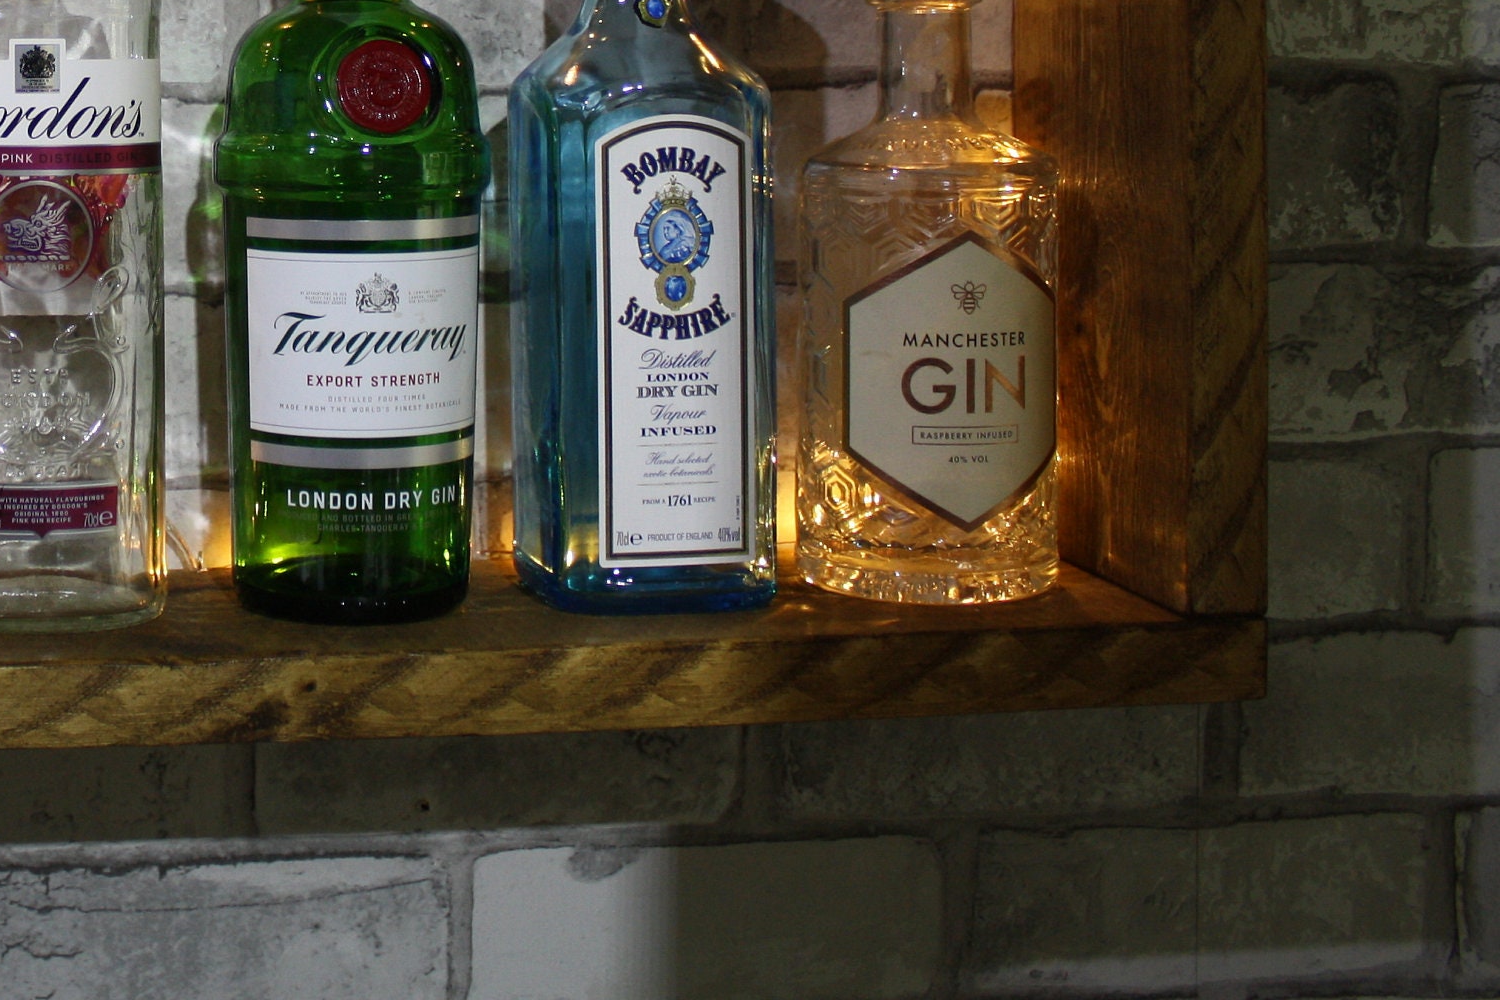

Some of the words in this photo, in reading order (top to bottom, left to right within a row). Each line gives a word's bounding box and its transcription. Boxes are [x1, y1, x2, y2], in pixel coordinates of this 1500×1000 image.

[1, 152, 33, 164] PINK
[39, 152, 112, 164] DISTILLED
[620, 146, 726, 194] BOMBAY
[617, 293, 731, 340] SAPPHIRE
[272, 311, 468, 367] Tanqueray
[902, 331, 1026, 348] MANCHESTER
[638, 348, 717, 370] Distilled
[306, 374, 363, 388] EXPORT
[370, 371, 441, 388] STRENGTH
[647, 371, 710, 383] LONDON
[636, 385, 678, 398] DRY
[681, 383, 719, 397] GIN
[901, 355, 1026, 415] GIN
[328, 395, 373, 403] DISTILLED
[403, 393, 427, 401] TIMES
[279, 402, 300, 411] MADE
[351, 405, 390, 413] WORLD'S
[395, 404, 423, 412] FINEST
[425, 398, 462, 411] BOTANICALS
[650, 402, 707, 425] Vapour
[640, 425, 717, 438] INFUSED
[920, 431, 973, 440] RASPBERRY
[976, 430, 1013, 439] INFUSED
[645, 452, 677, 465] Hand
[676, 452, 714, 464] selected
[971, 455, 989, 463] VOL
[643, 470, 668, 478] exotic
[669, 464, 716, 477] botanicals
[20, 496, 53, 504] NATURAL
[56, 494, 105, 504] FLAVOURINGS
[287, 489, 374, 510] LONDON
[384, 490, 423, 510] DRY
[431, 485, 456, 505] GIN
[667, 494, 692, 507] 1761
[647, 532, 675, 542] PRODUCT
[676, 532, 684, 541] OF
[686, 531, 714, 541] ENGLAND
